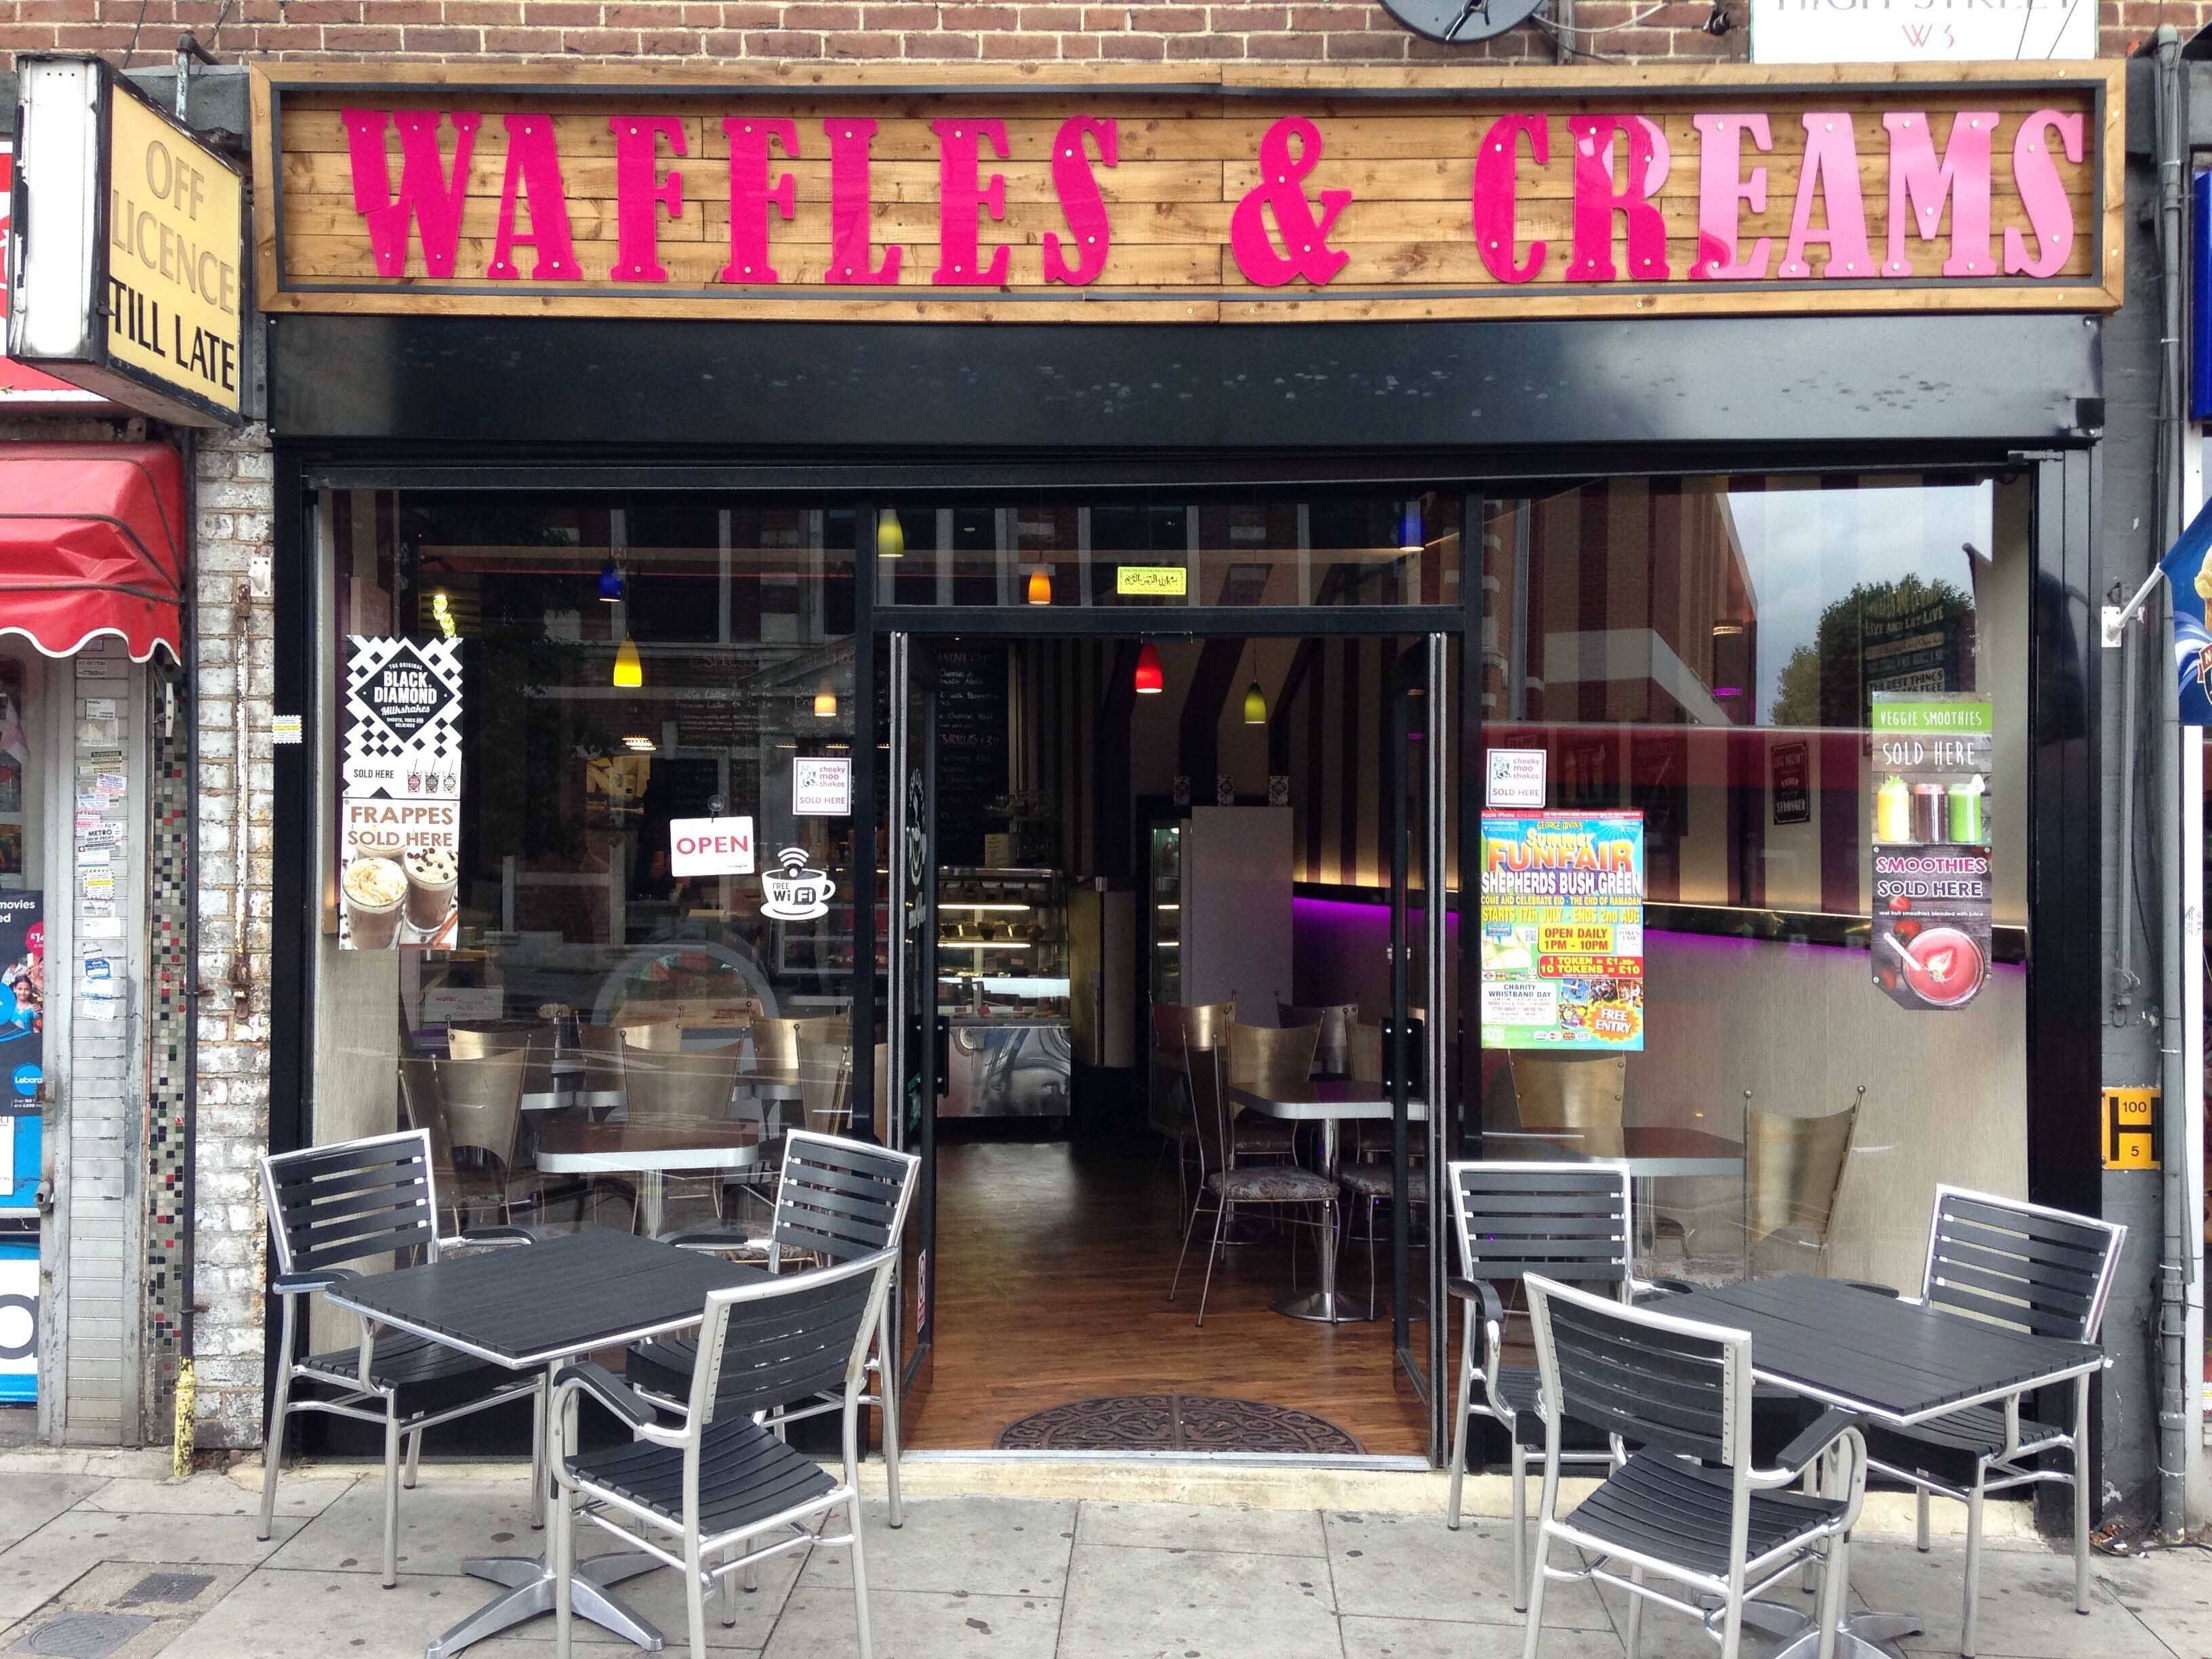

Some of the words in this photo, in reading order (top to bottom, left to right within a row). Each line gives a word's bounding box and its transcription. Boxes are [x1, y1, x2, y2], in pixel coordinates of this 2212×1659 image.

[145, 140, 205, 221] OFF
[340, 108, 1118, 286] WAFFLES
[1233, 116, 1370, 287] &
[1473, 108, 2084, 283] CREAMS
[110, 188, 235, 316] LICENCE
[109, 274, 165, 357] TILL
[175, 314, 235, 392] LATE
[374, 687, 437, 704] DIAMOND
[381, 704, 430, 716] Milkshakes
[1880, 713, 1919, 726] VEGGIE
[1923, 712, 1982, 726] SMOOTHIES
[1883, 743, 1924, 765] SOLD
[1934, 742, 1975, 765] HERE
[353, 769, 372, 779] SOLD
[375, 769, 394, 779] HERE
[819, 766, 846, 774] cheeky
[350, 806, 453, 825] FRAPPES
[348, 830, 400, 846] SOLD
[406, 830, 453, 846] HERE
[676, 835, 748, 855] OPEN
[1487, 839, 1635, 872] FUNFAIR
[1876, 857, 1988, 874] SMOOTHIES
[1481, 872, 1557, 895] SHEPHERDS
[1559, 872, 1595, 895] BUSH
[1598, 872, 1641, 895] GREEN
[1877, 880, 1928, 897] SOLD
[1932, 881, 1983, 897] HERE
[1481, 896, 1499, 905] COME
[1515, 896, 1553, 905] CELEBRATE
[1570, 897, 1583, 905] THE
[1584, 897, 1598, 905] END
[1599, 897, 1609, 905] OF
[1610, 897, 1641, 905] RAMADAN
[1482, 907, 1515, 922] STARTS
[1542, 907, 1562, 922] JULY
[1572, 908, 1597, 922] ENDS
[1620, 909, 1640, 922] AUG
[1545, 928, 1573, 939] OPEN
[1577, 928, 1607, 939] DAILY
[1544, 941, 1567, 950] 1PM
[1580, 941, 1608, 950] 10PM
[1557, 965, 1604, 974] TOKENS
[1618, 966, 1640, 975] £10
[1601, 1008, 1627, 1020] FREE
[1595, 1019, 1632, 1033] ENTRY
[2123, 1101, 2147, 1113] 100
[2131, 1146, 2139, 1157] 5
